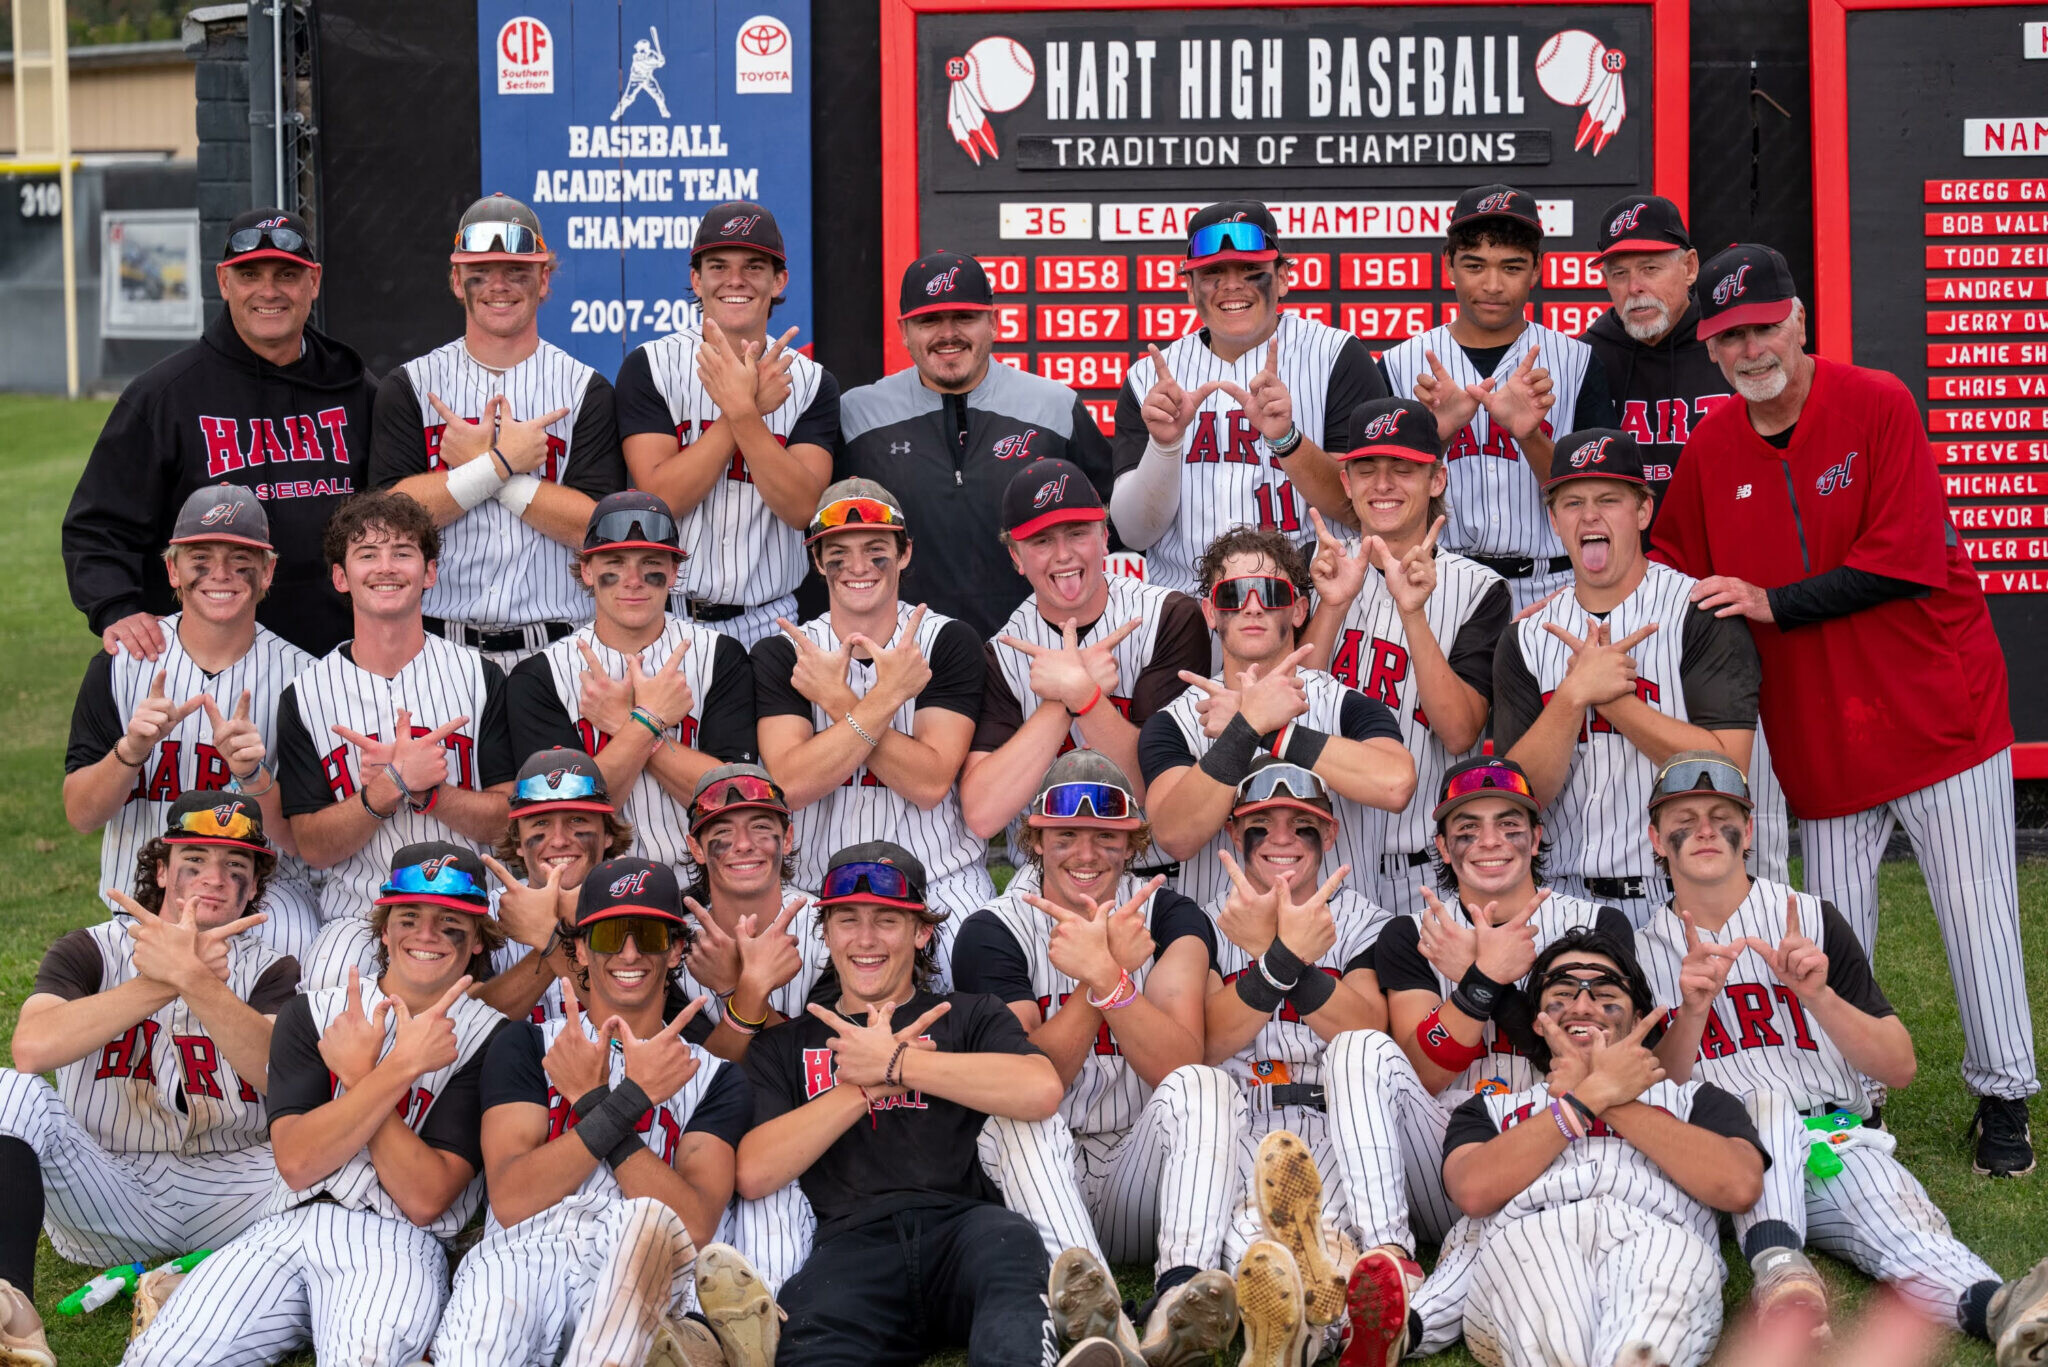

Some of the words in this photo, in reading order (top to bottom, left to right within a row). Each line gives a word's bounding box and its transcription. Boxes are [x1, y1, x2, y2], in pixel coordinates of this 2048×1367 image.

[502, 21, 547, 65] CIF
[502, 68, 549, 79] Southern
[740, 71, 790, 82] TOYOTA
[1046, 40, 1157, 121] HART
[1179, 38, 1283, 120] HIGH
[1308, 35, 1525, 118] BASEBALL
[506, 80, 546, 90] Section
[569, 125, 728, 158] BASEBALL
[1052, 137, 1241, 167] TRADITION
[1258, 136, 1297, 165] OF
[1316, 133, 1516, 164] CHAMPIONS
[533, 169, 673, 203] ACADEMIC
[680, 168, 759, 200] TEAM
[1941, 182, 2009, 200] GREGG
[20, 182, 62, 217] 310
[1026, 208, 1066, 234] 36
[1943, 215, 1984, 233] BOB
[1944, 248, 1999, 266] TODD
[2011, 247, 2048, 265] ZEI
[1043, 260, 1120, 289] 1958
[1352, 257, 1420, 287] 1961
[1550, 257, 1604, 286] 196
[1944, 280, 2034, 299] ANDREW
[1044, 309, 1121, 338] 1967
[1144, 308, 1199, 337] 197
[1349, 308, 1425, 337] 1976
[1945, 313, 2012, 332] JERRY
[1945, 345, 2010, 363] JAMIE
[1045, 356, 1122, 386] 1984
[1945, 379, 2006, 397] CHRIS
[1946, 411, 2031, 429] TREVOR
[199, 406, 350, 478] HART
[1946, 443, 2018, 462] STEVE
[1946, 476, 2038, 494] MICHAEL
[1254, 480, 1301, 532] 11
[1964, 541, 2017, 559] YLER
